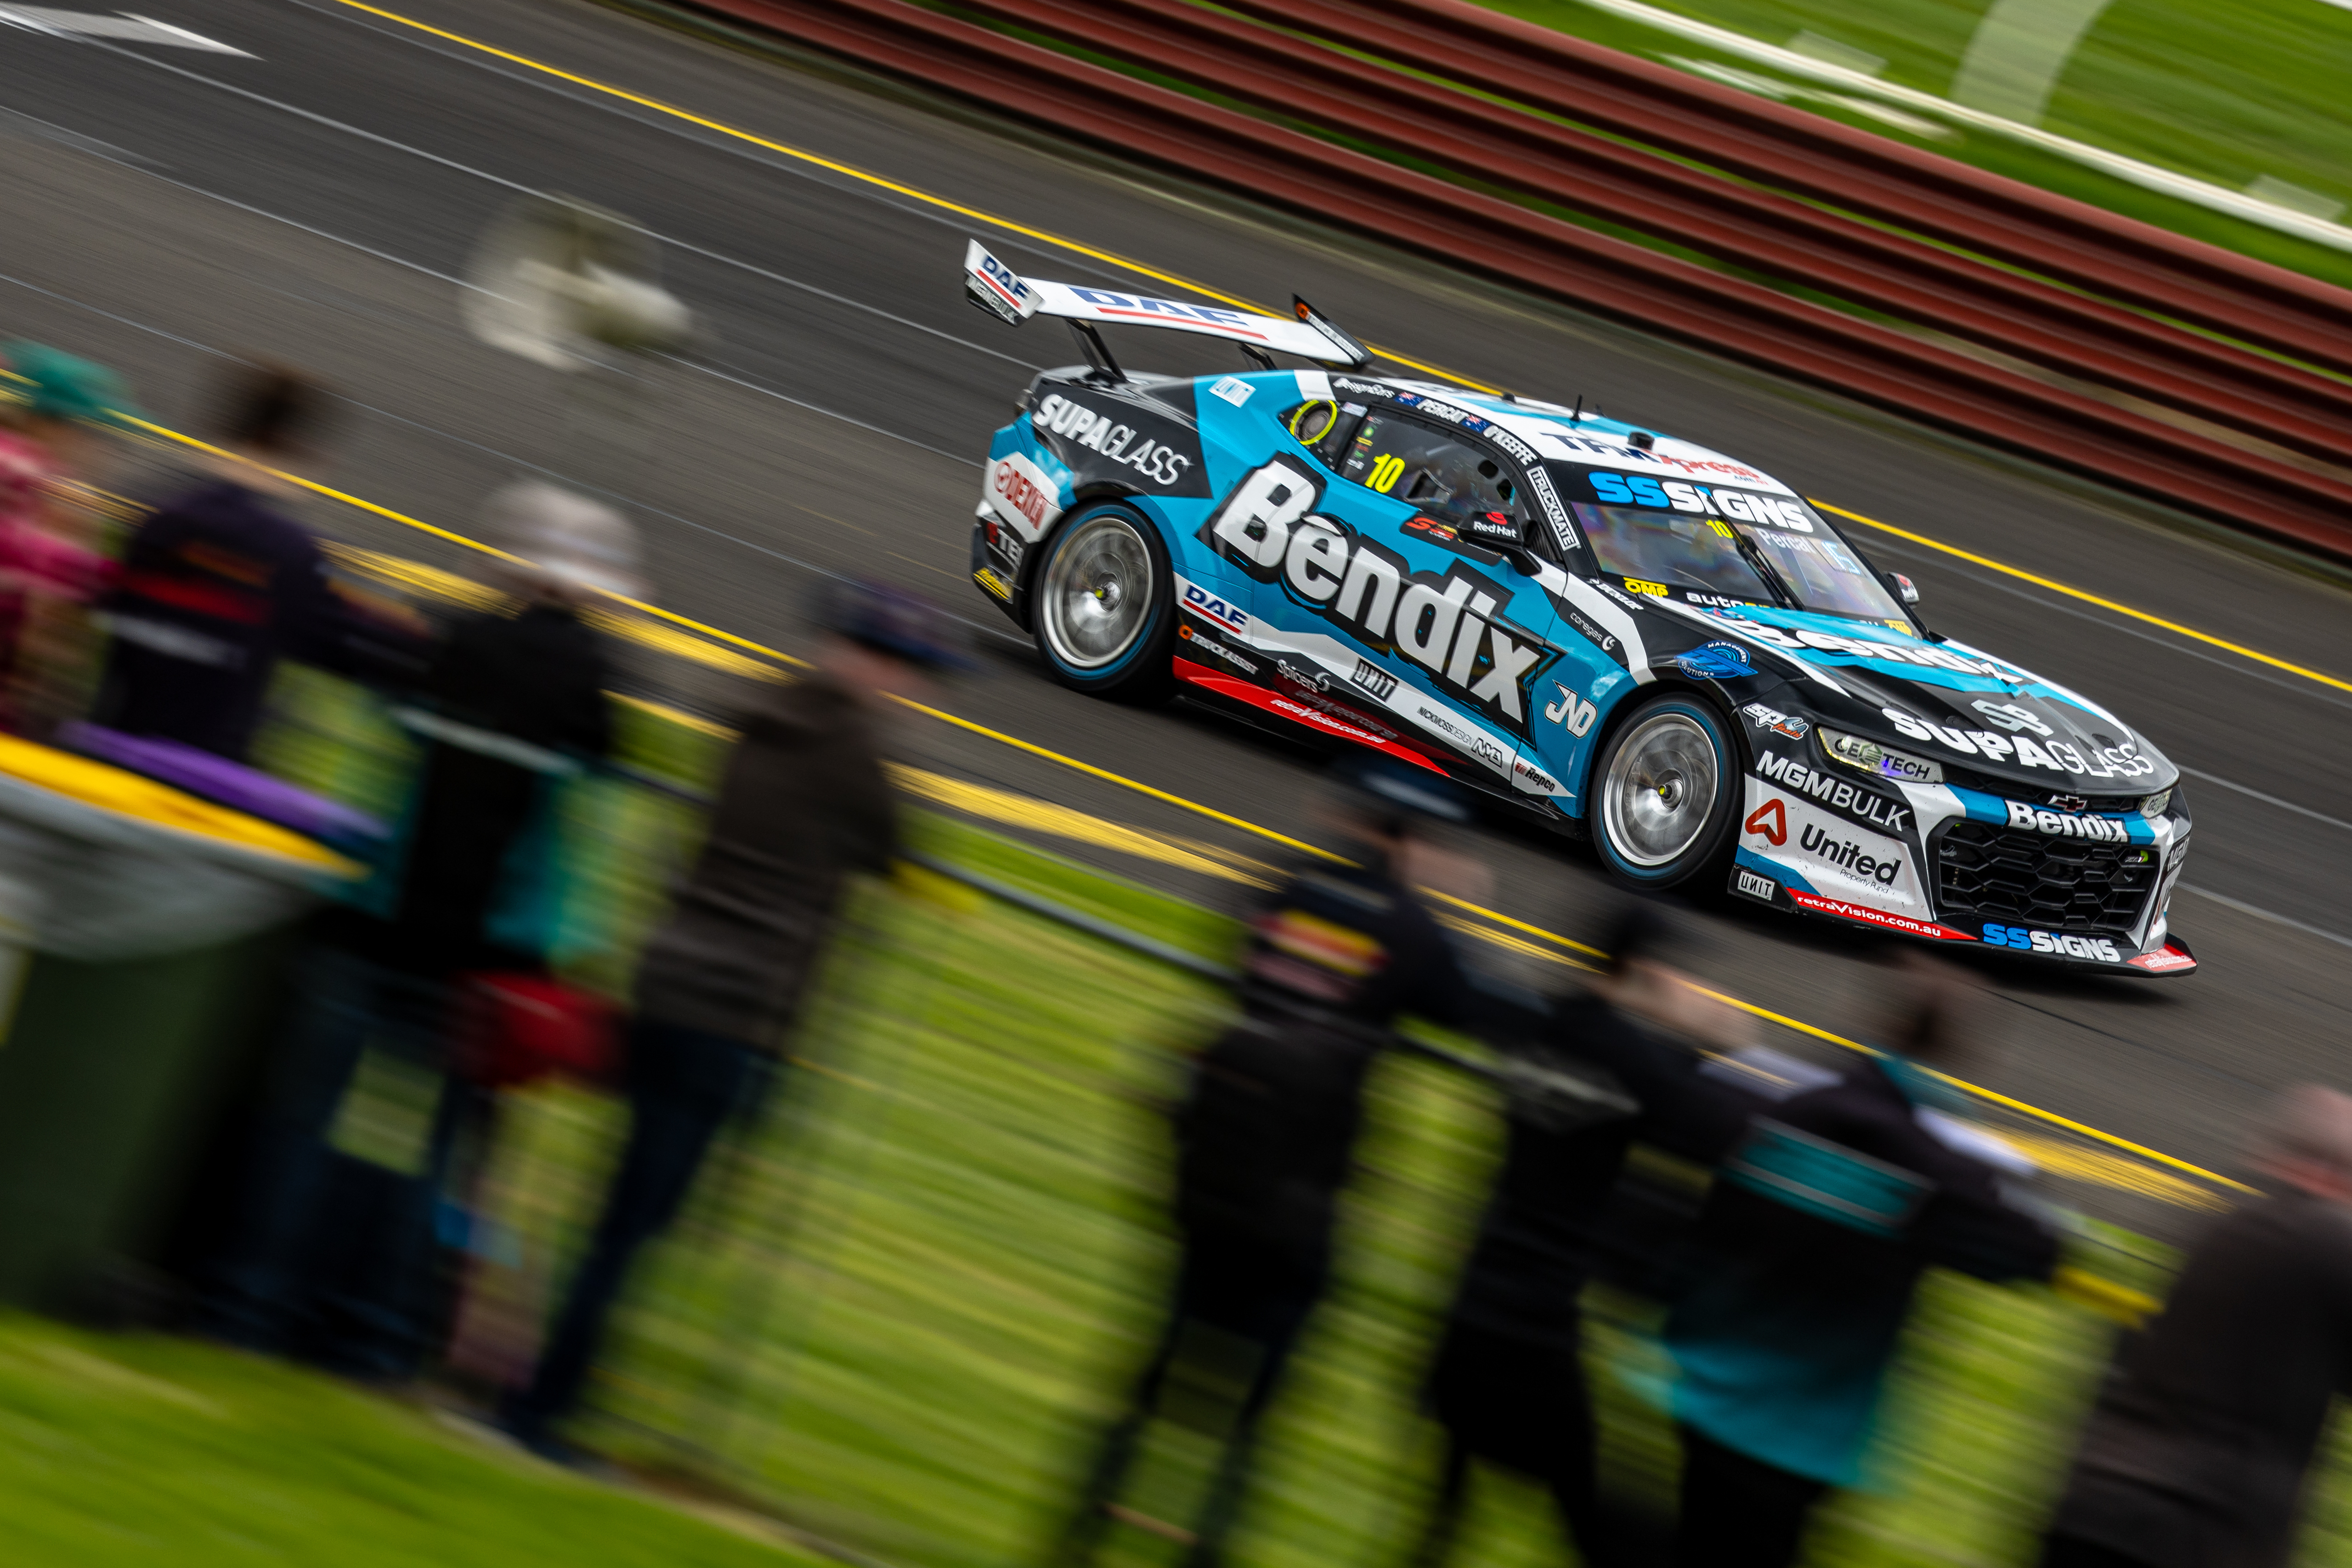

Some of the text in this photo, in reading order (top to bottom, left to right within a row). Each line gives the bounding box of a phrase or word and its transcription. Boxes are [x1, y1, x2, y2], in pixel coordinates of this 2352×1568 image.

[982, 255, 1031, 300] DAF
[1065, 285, 1250, 327] DAF
[1032, 394, 1191, 485] SUPAGLASS
[1365, 453, 1405, 493] 10
[1531, 468, 1575, 547] TRUCKMATE
[1473, 521, 1496, 533] Red
[1496, 525, 1517, 538] Hat
[1705, 519, 1734, 539] 10
[1184, 584, 1249, 627] DAF
[1213, 459, 1540, 724] Bendix
[1624, 578, 1668, 598] OMP
[1570, 612, 1604, 641] coregas
[1276, 659, 1318, 693] Spicers
[1882, 708, 2154, 778] SUPAGLASS
[1525, 766, 1555, 792] Repco
[1756, 750, 1910, 832] MGMBULK
[2007, 800, 2128, 843] Bendix
[1799, 823, 1901, 887] United
[1740, 873, 1772, 899] UNIT
[1840, 869, 1889, 894] Property Fund
[1797, 895, 1941, 937] retraVision.com.au
